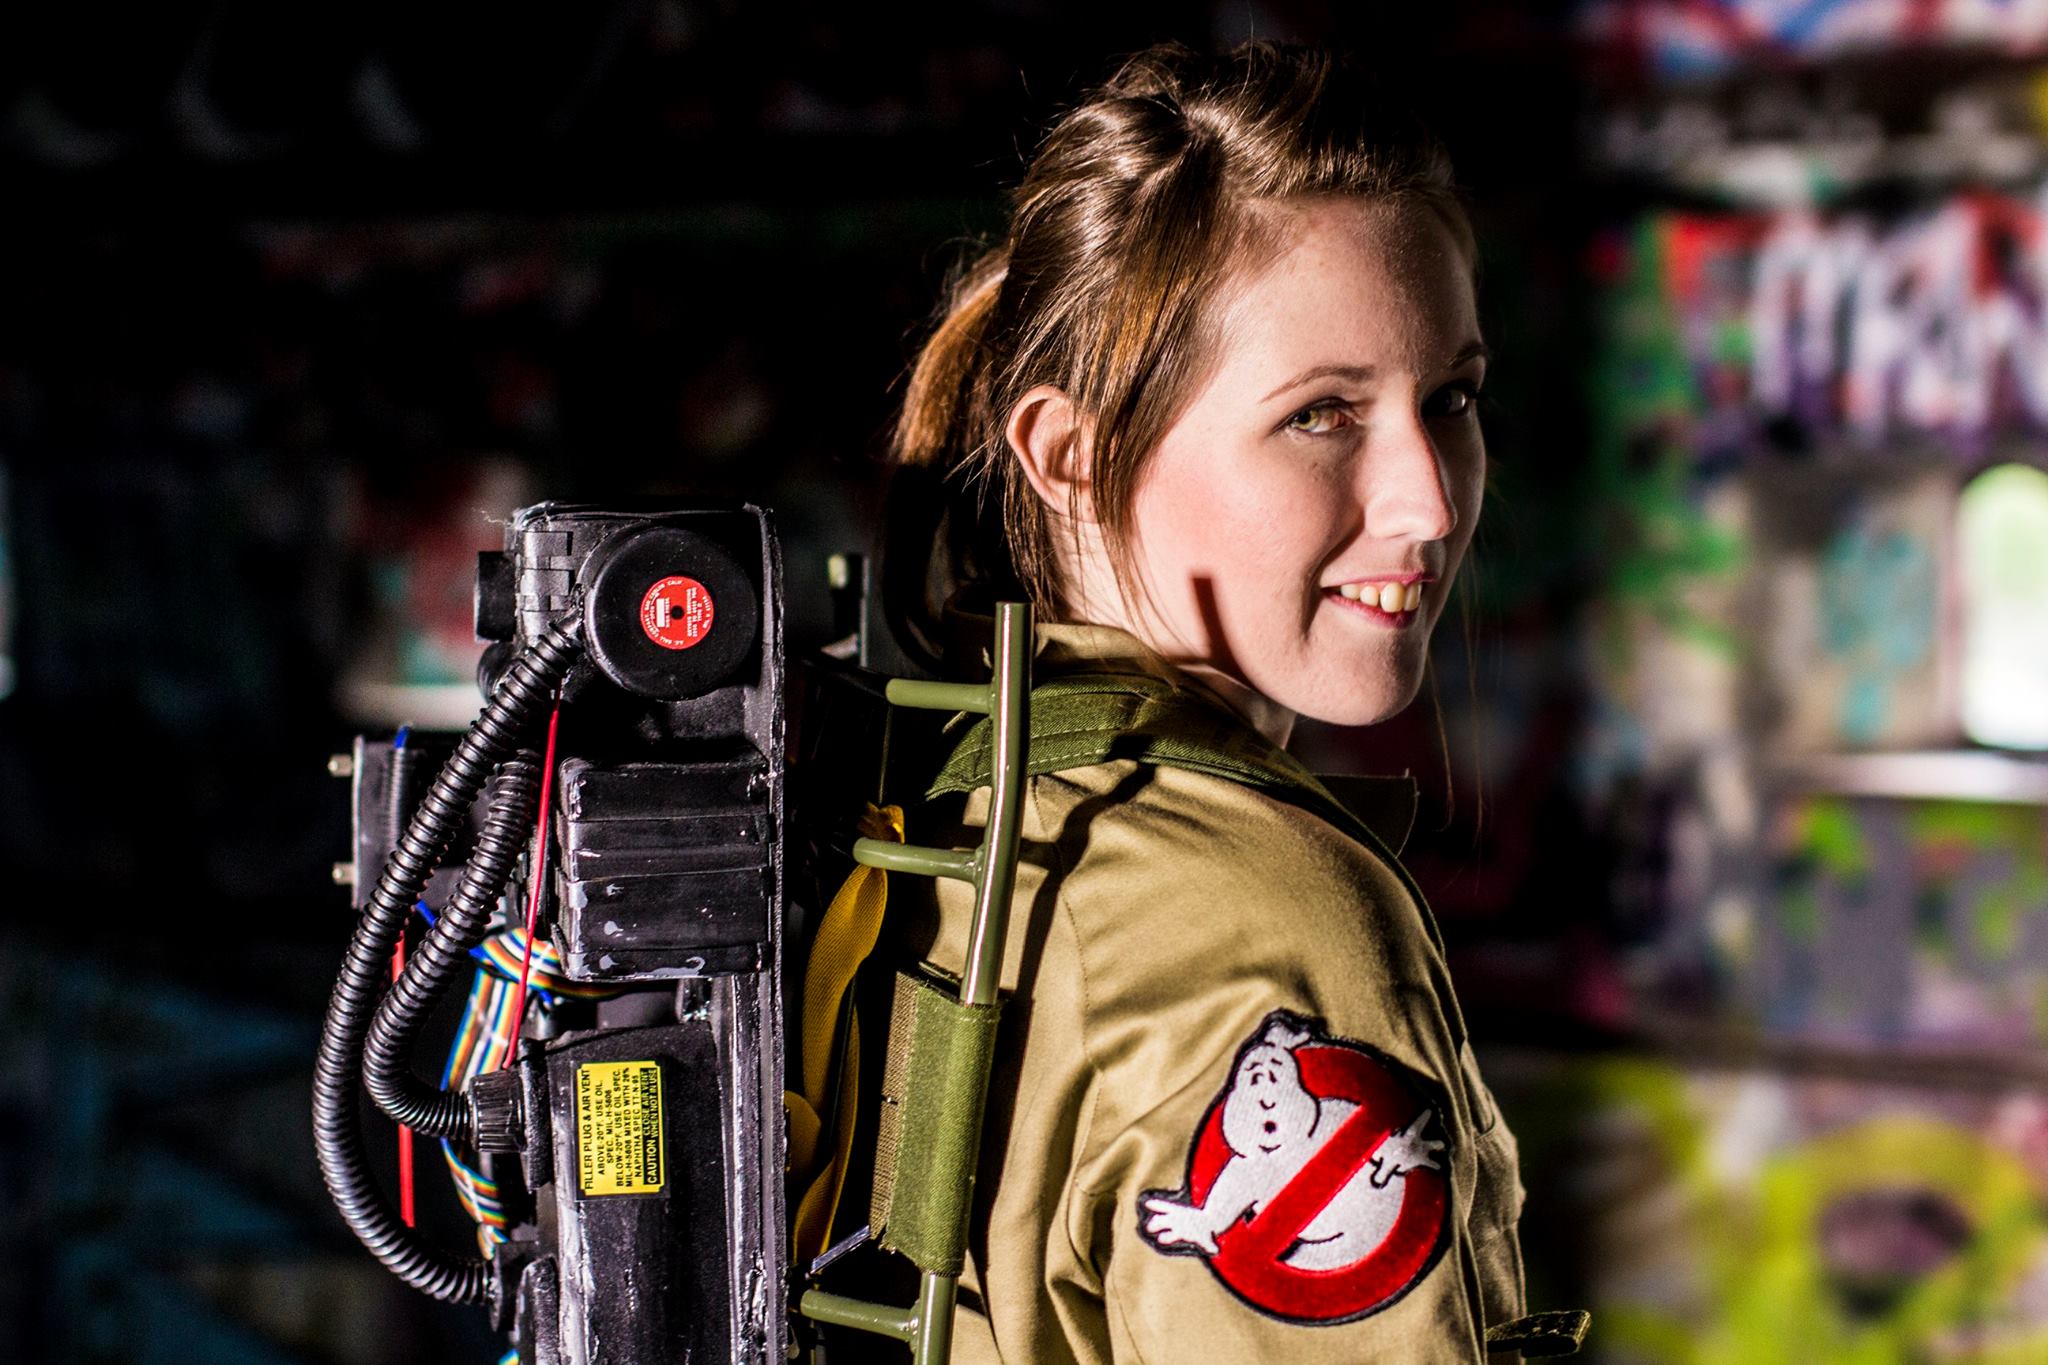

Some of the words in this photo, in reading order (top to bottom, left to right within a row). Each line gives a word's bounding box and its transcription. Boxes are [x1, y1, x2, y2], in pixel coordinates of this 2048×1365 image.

[582, 1069, 591, 1093] VENT
[649, 1069, 657, 1083] USE
[642, 1092, 650, 1106] AIR
[650, 1085, 657, 1093] IN
[583, 1095, 591, 1111] AIR
[650, 1095, 658, 1111] NOT
[624, 1109, 632, 1136] MIXED
[643, 1108, 651, 1136] CLOSE
[651, 1113, 659, 1138] WHEN
[584, 1124, 593, 1152] PLUG
[584, 1155, 594, 1189] FILLER
[647, 1139, 658, 1184] CAUTION
